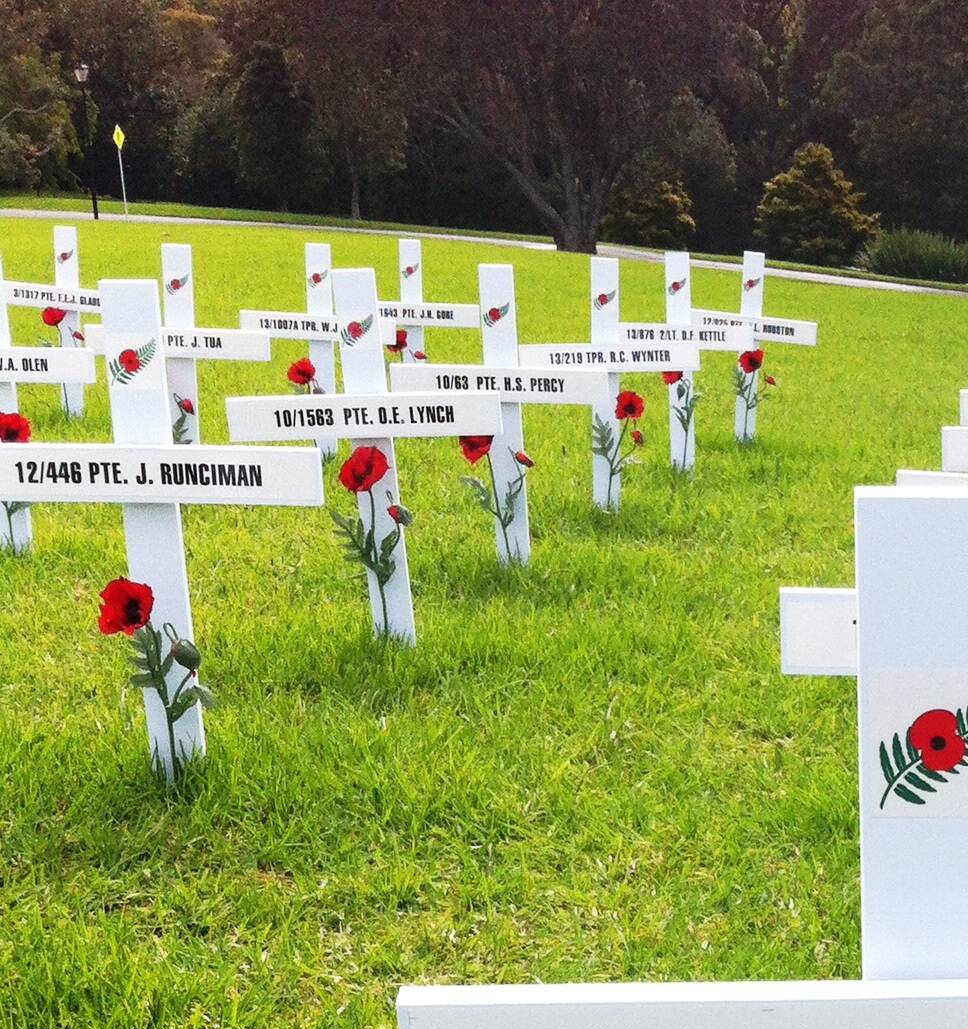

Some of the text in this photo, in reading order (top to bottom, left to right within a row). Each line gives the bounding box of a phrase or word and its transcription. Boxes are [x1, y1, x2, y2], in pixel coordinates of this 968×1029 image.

[301, 320, 320, 332] TPR.
[168, 335, 188, 348] PTE.
[191, 336, 200, 348] J.
[204, 336, 222, 348] TUA
[699, 330, 726, 342] KETTLE
[586, 352, 606, 364] TPR.
[610, 350, 628, 363] R.C.
[632, 350, 670, 362] WYNTER
[22, 358, 48, 372] OLEN
[436, 375, 565, 393] 10/63 PTE. H.S. PERCY
[273, 404, 455, 428] 10/1563 PTE. O.E. LYNCH
[14, 461, 262, 487] 12/446 PTE. J. RUNCIMAN
